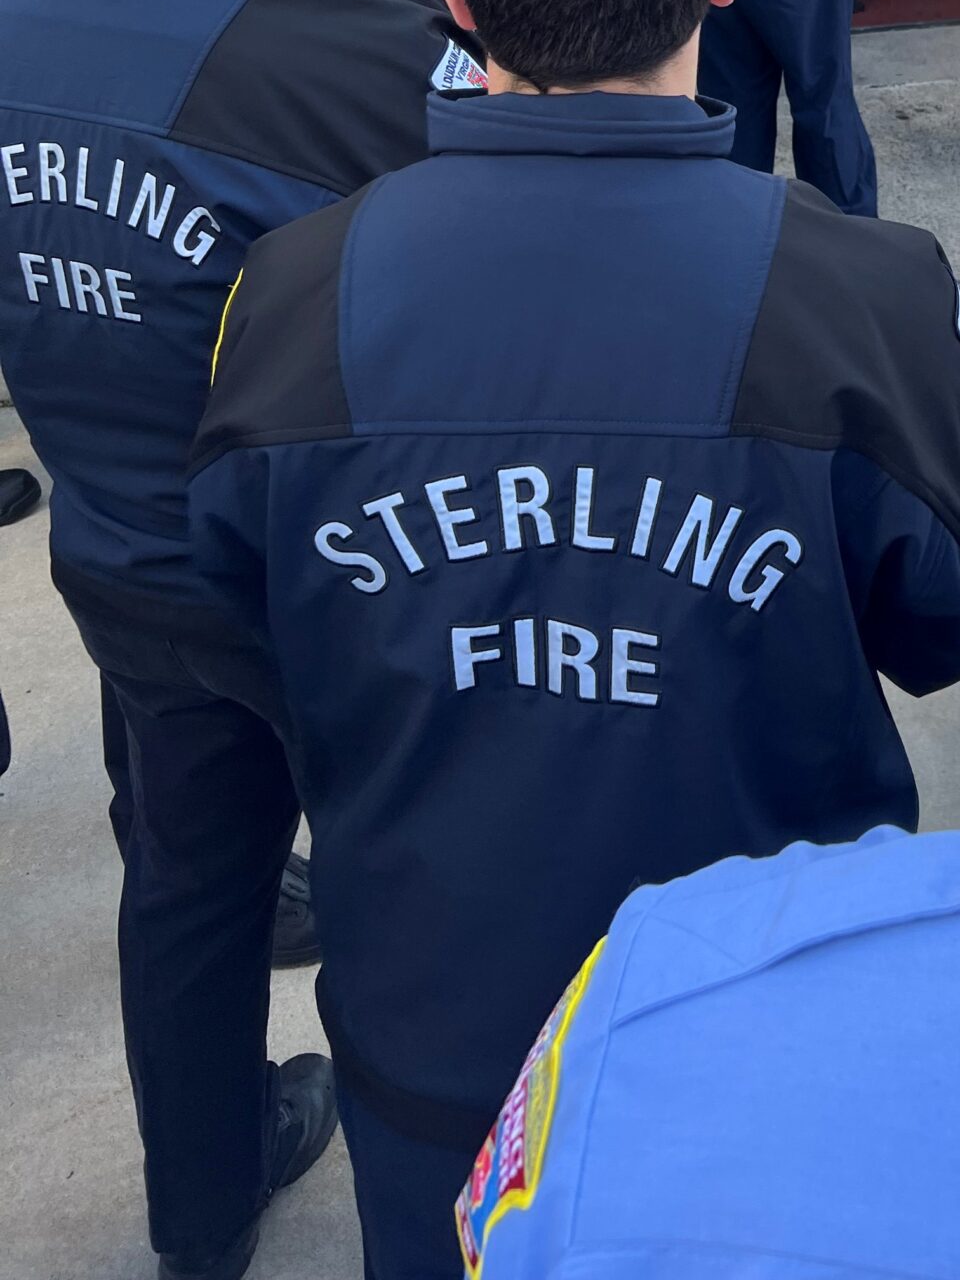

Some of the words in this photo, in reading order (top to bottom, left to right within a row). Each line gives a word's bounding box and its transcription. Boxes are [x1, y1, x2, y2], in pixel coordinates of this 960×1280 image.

[18, 252, 142, 322] FIRE
[313, 465, 802, 612] STERLING
[450, 618, 659, 706] FIRE
